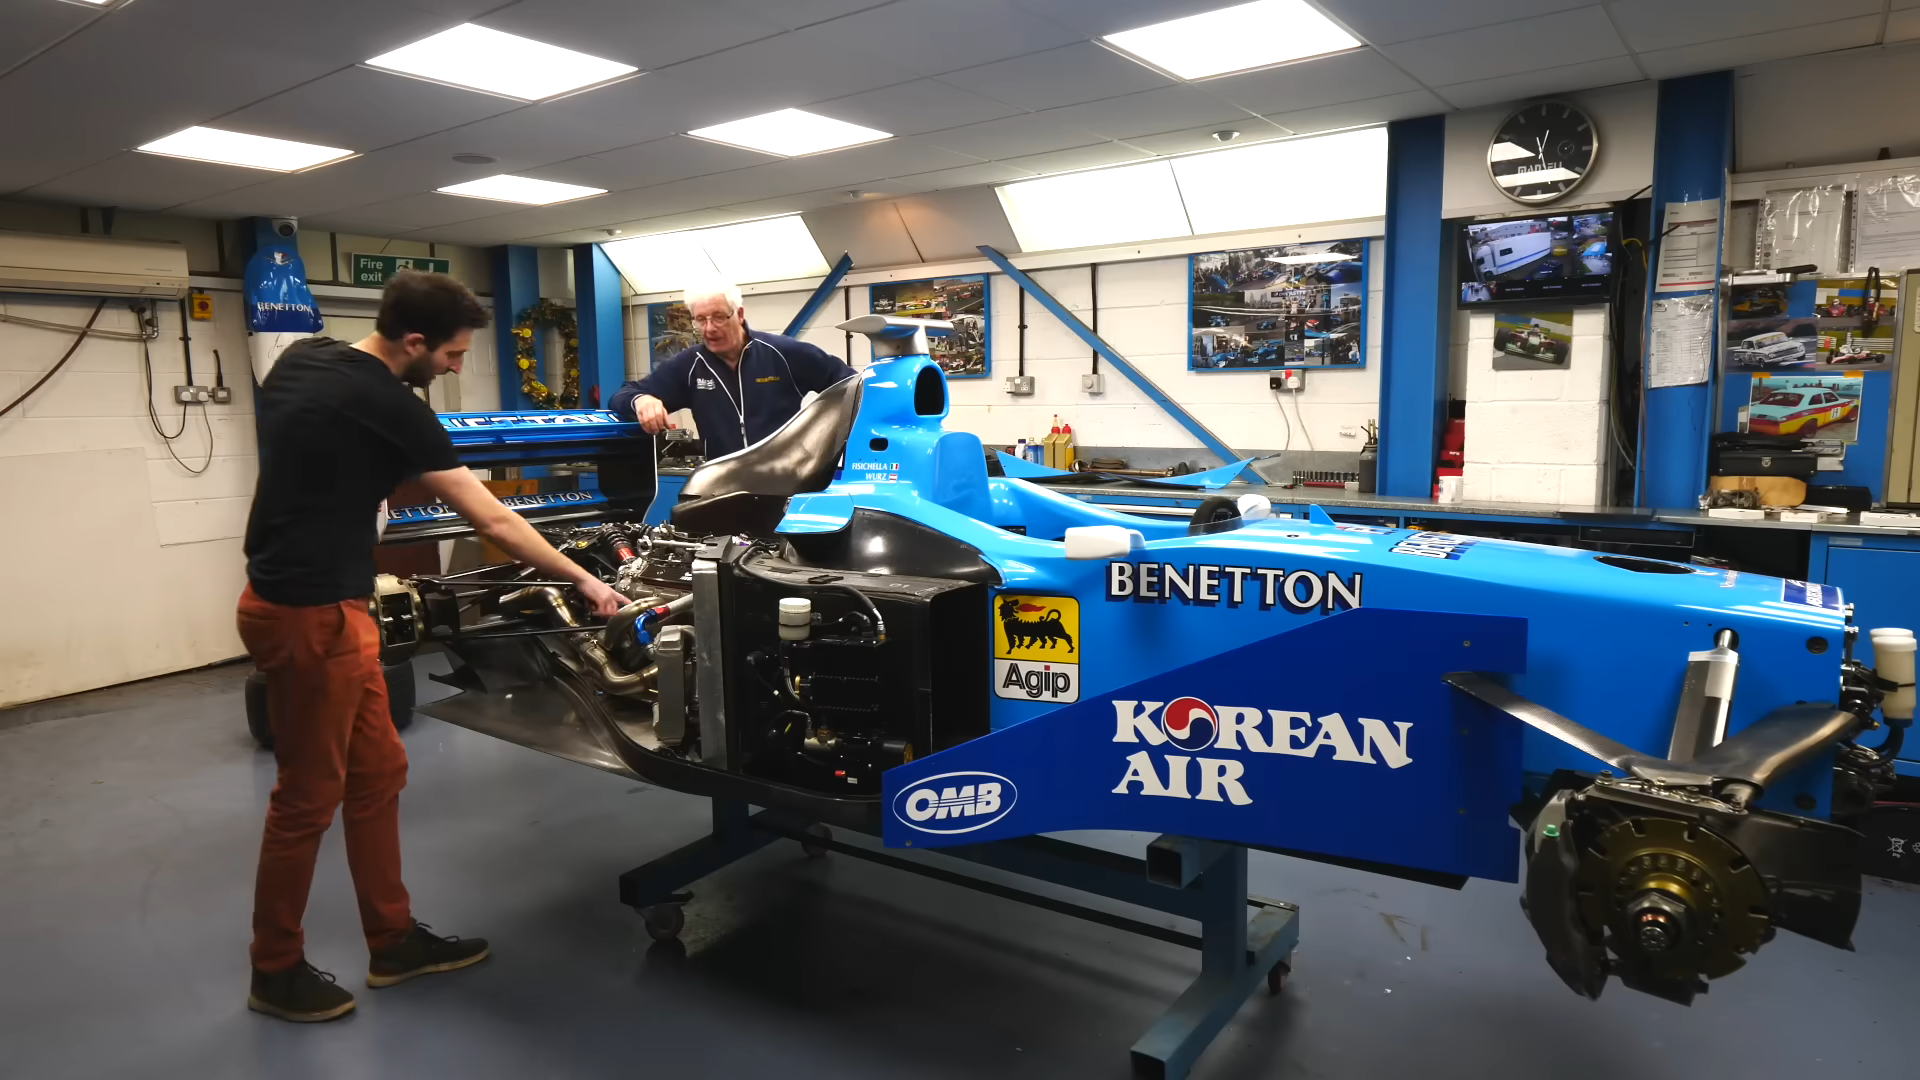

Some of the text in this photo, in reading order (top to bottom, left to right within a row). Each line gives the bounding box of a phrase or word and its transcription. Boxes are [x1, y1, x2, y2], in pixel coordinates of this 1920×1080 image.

[360, 258, 383, 269] Fire
[361, 272, 382, 282] exit
[257, 302, 311, 311] BENETTON
[503, 491, 594, 506] BENETTON
[1109, 561, 1362, 611] BENETTON
[1002, 663, 1071, 698] Agip
[1112, 696, 1414, 769] KOREAN
[1112, 751, 1253, 806] AIR
[905, 782, 1002, 822] OMB
